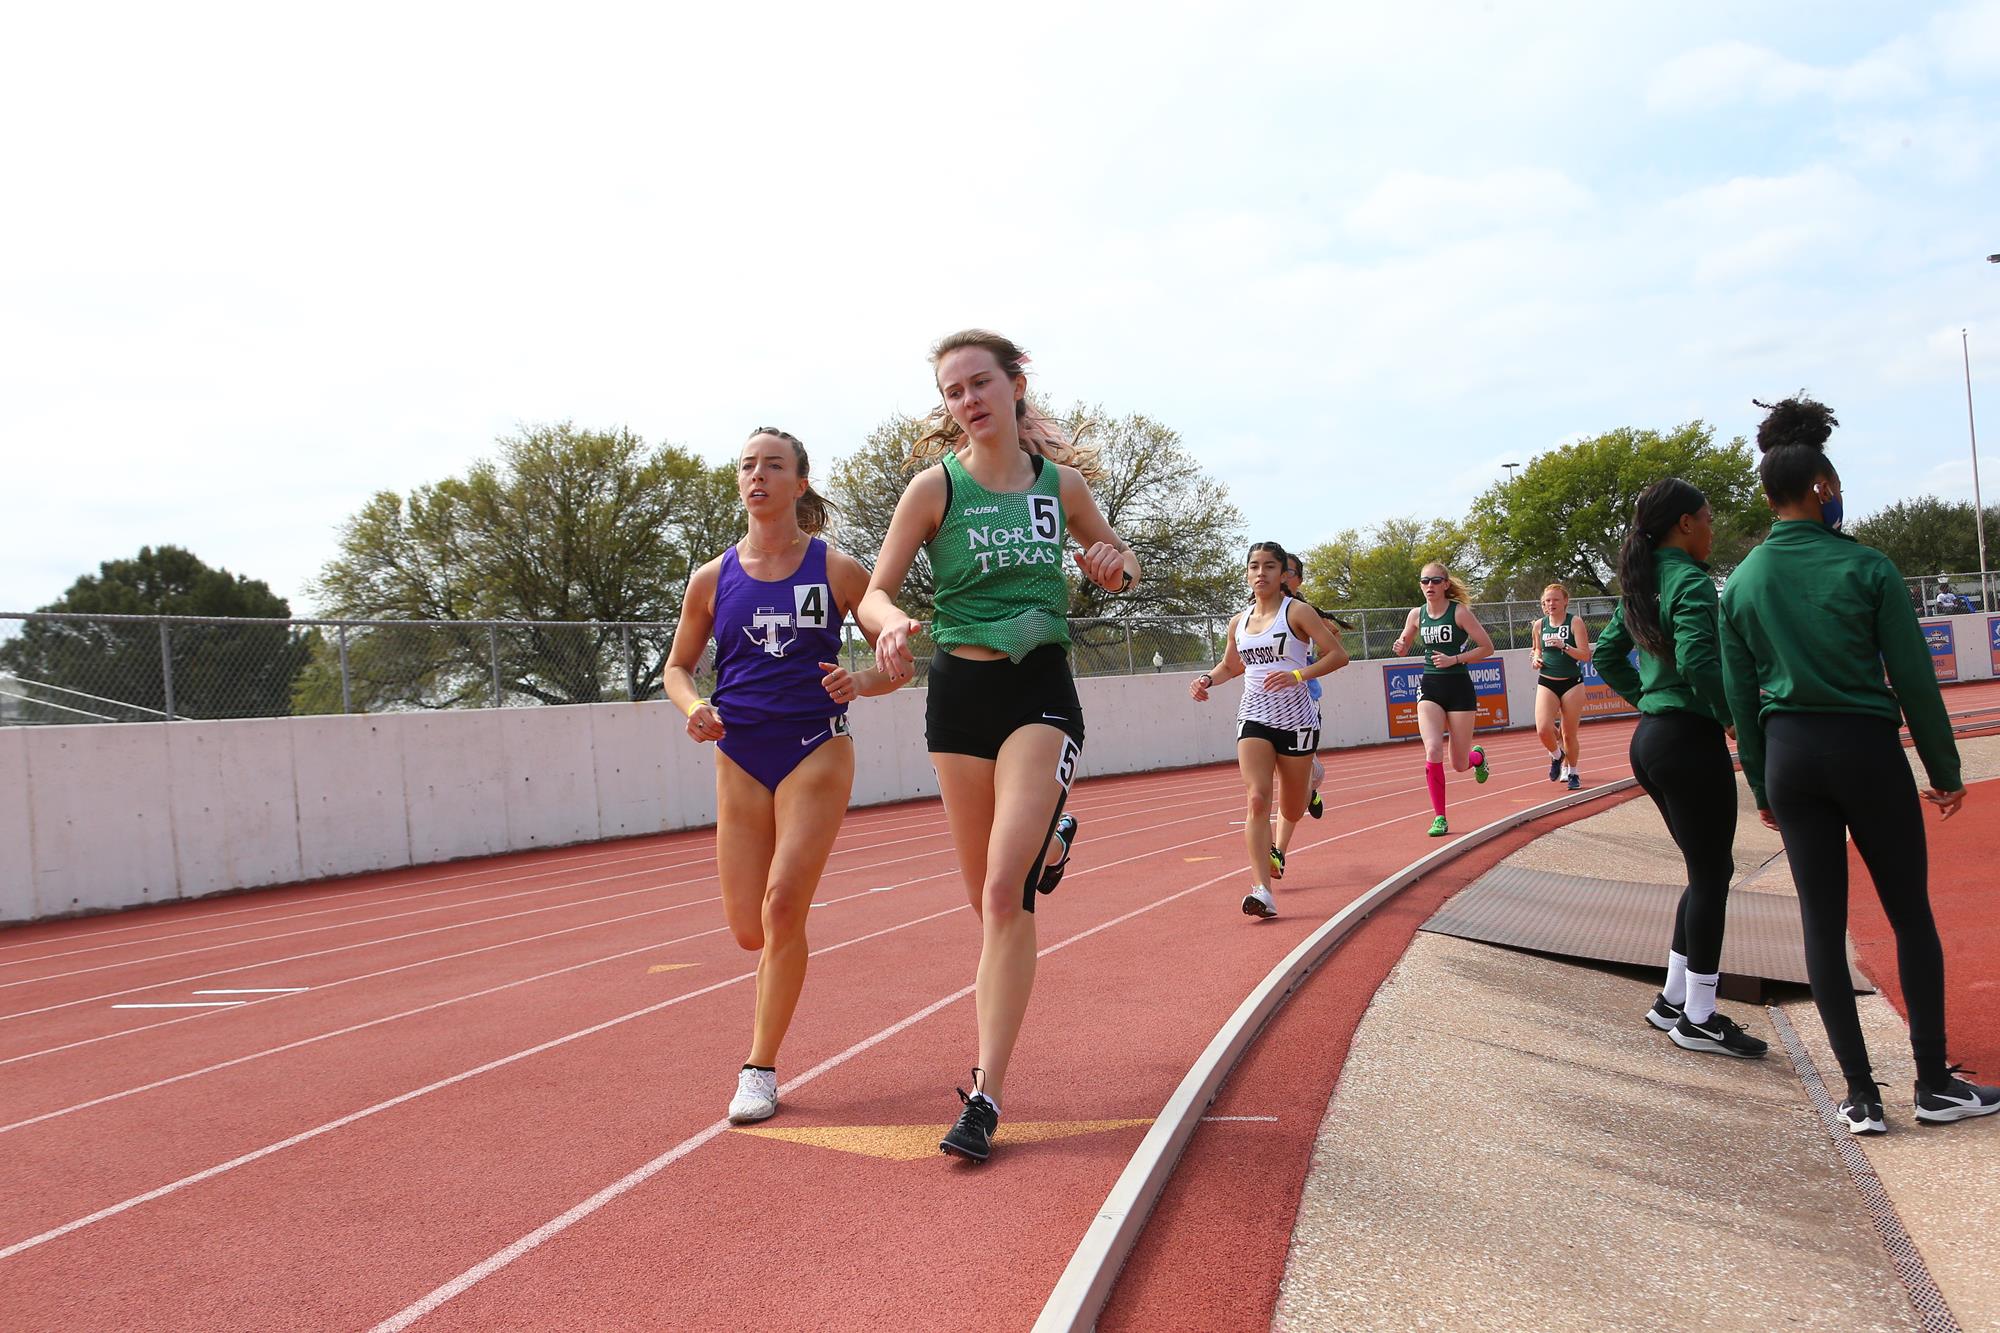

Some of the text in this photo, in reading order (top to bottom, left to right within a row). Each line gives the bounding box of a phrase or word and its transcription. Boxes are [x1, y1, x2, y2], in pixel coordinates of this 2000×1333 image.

[1033, 498, 1057, 539] 5
[967, 525, 1034, 550] NOR
[975, 548, 1055, 573] TEXAS
[800, 586, 825, 625] 4
[1273, 632, 1288, 655] 7
[1440, 625, 1451, 642] 6
[1559, 626, 1568, 638] 8
[1407, 668, 1500, 688] NAT MPIONS
[1583, 663, 1598, 678] 16
[1299, 727, 1313, 750] 7
[1060, 741, 1078, 786] 5
